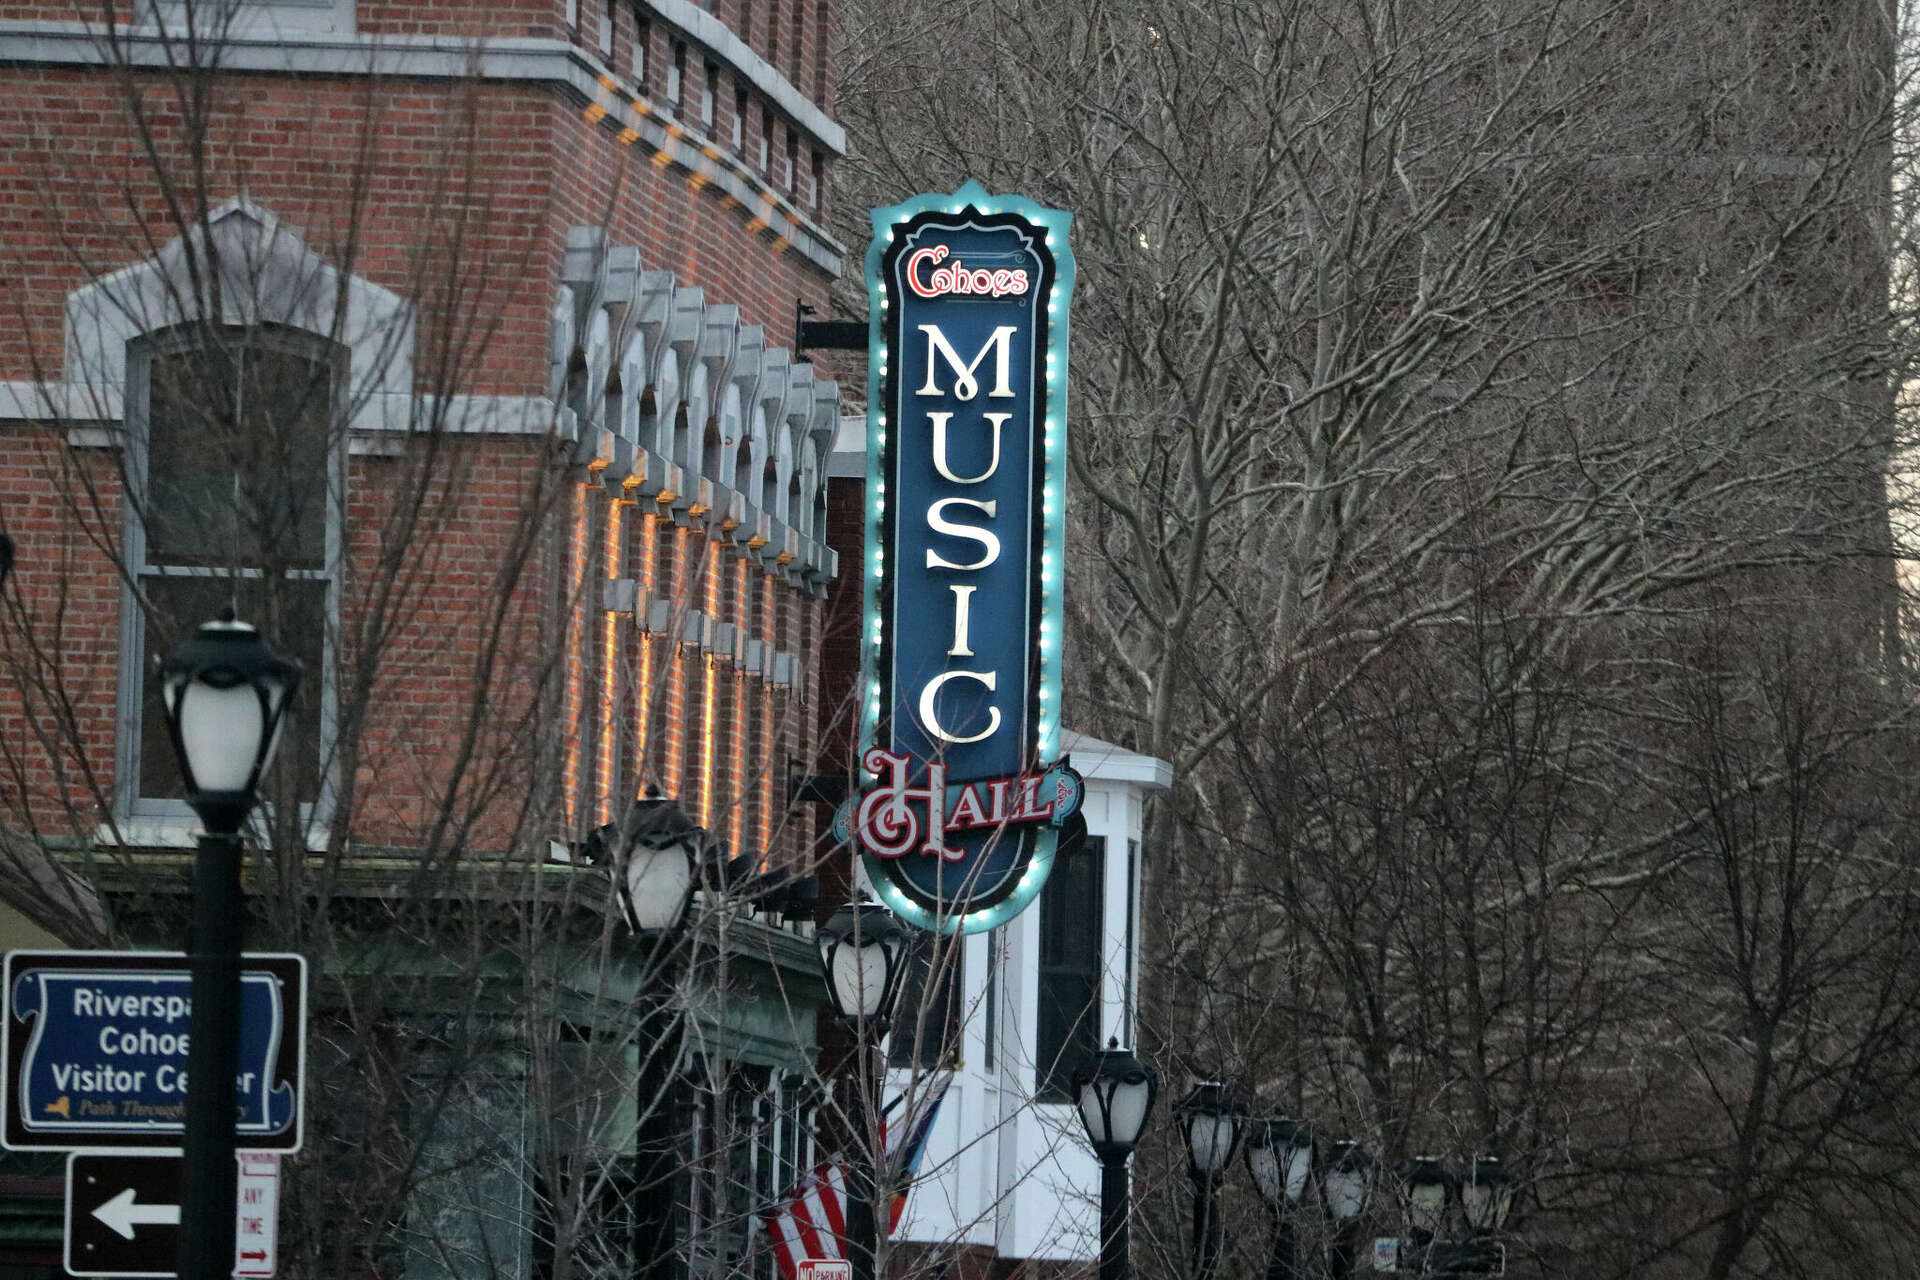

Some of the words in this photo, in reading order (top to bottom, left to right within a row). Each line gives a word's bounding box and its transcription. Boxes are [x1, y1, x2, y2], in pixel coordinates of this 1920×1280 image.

[906, 245, 1029, 298] Cohoes
[915, 324, 1018, 744] MUSIC
[857, 747, 1054, 862] HALL
[74, 988, 192, 1023] Riversp
[99, 1027, 190, 1056] Cohoe
[51, 1062, 146, 1092] Visitor
[243, 1187, 263, 1204] ANY
[242, 1217, 263, 1235] TIME
[800, 1267, 814, 1280] NO
